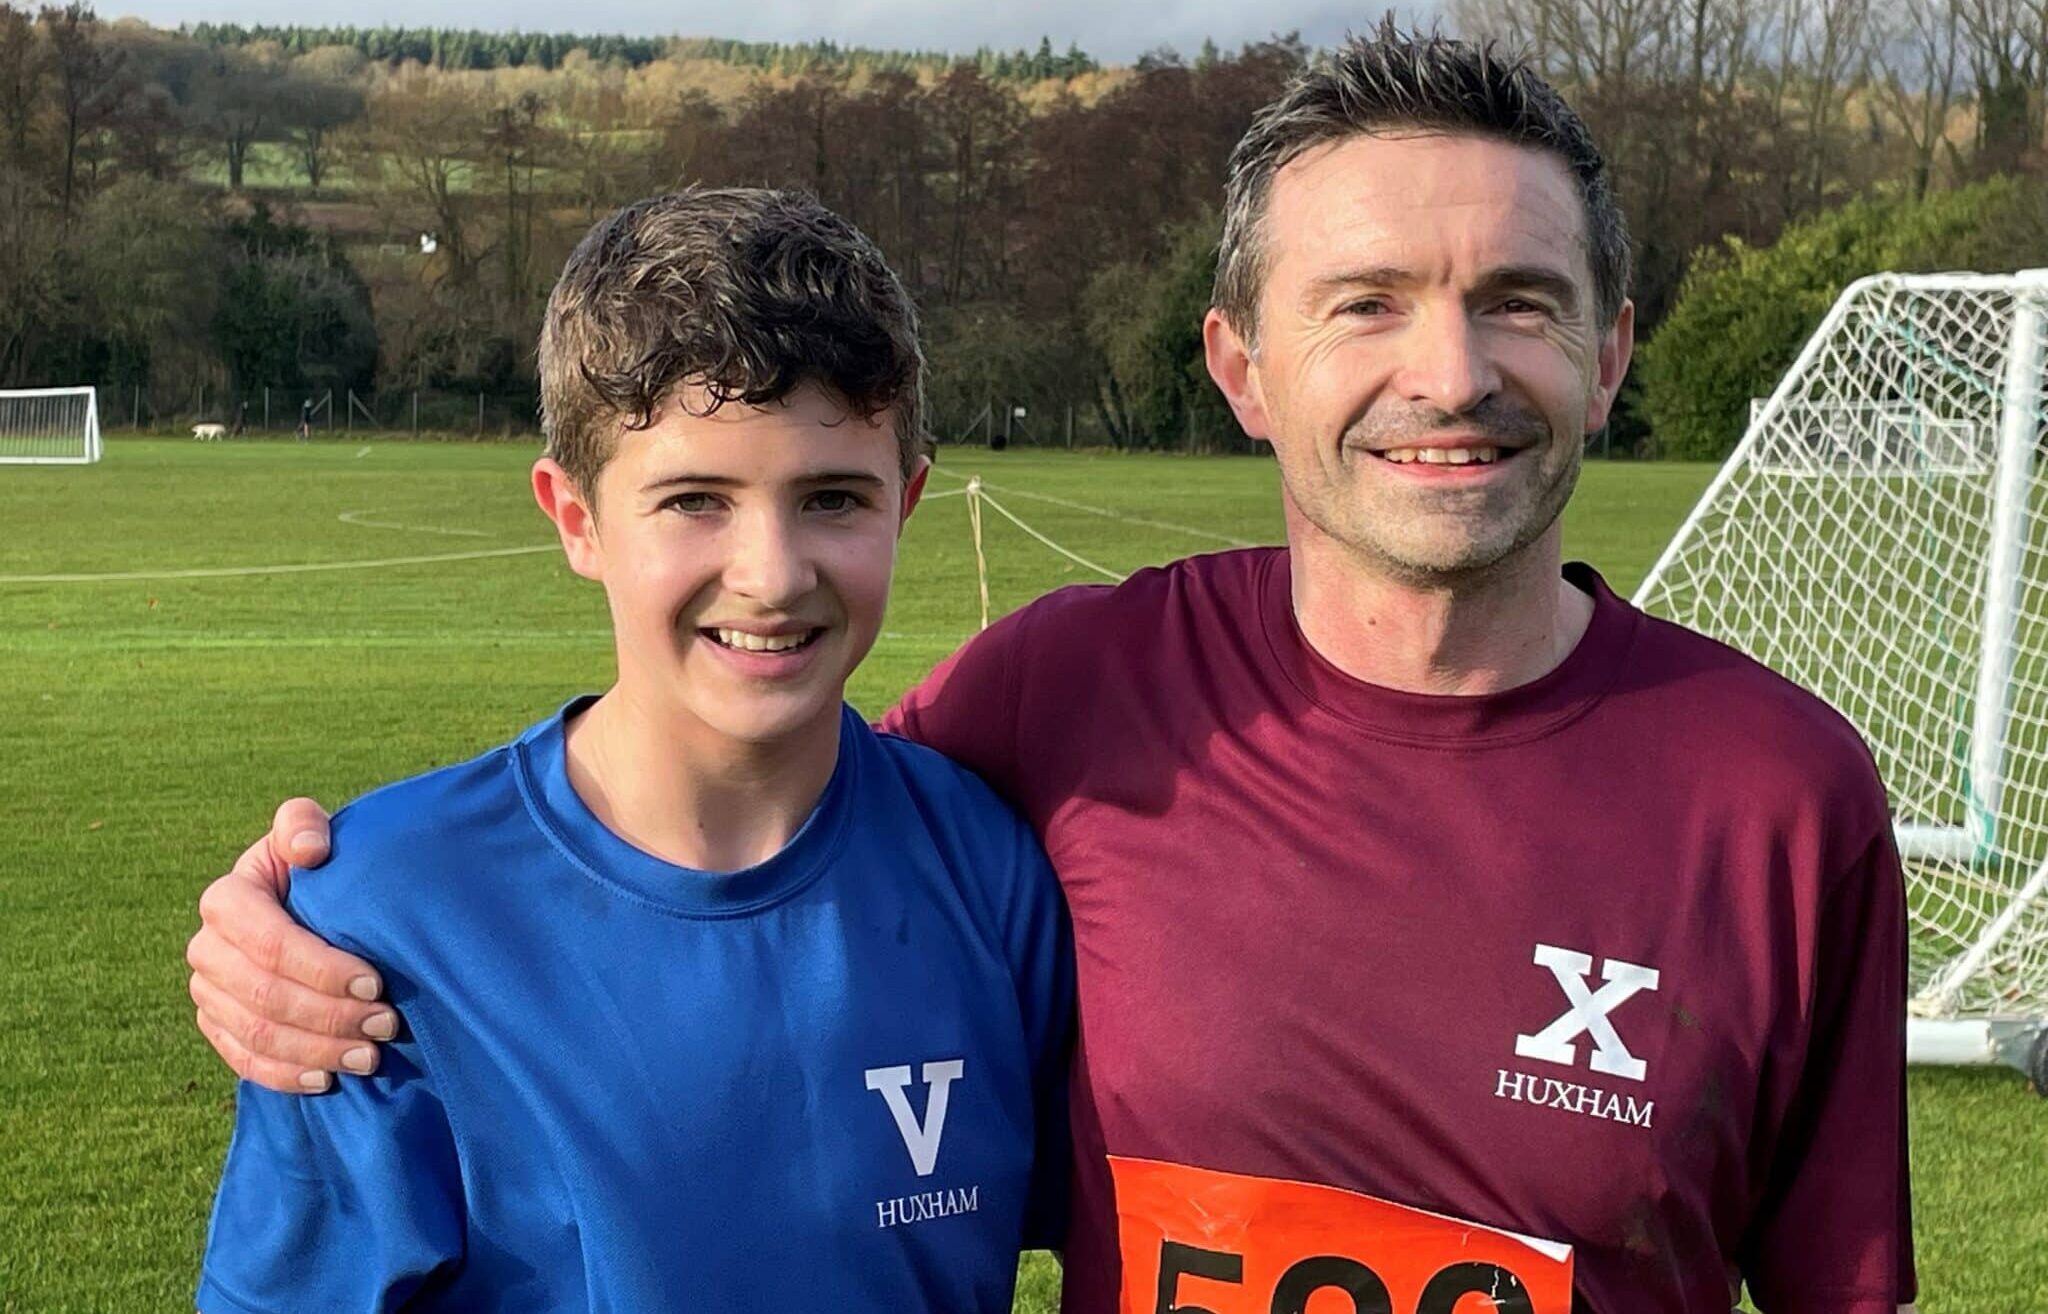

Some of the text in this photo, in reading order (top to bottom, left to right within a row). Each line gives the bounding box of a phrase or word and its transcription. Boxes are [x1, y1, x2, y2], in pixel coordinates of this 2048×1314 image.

[1515, 944, 1659, 1082] X
[865, 1059, 964, 1176] V
[1494, 1069, 1654, 1128] HUXHAM
[876, 1185, 979, 1228] HUXHAM
